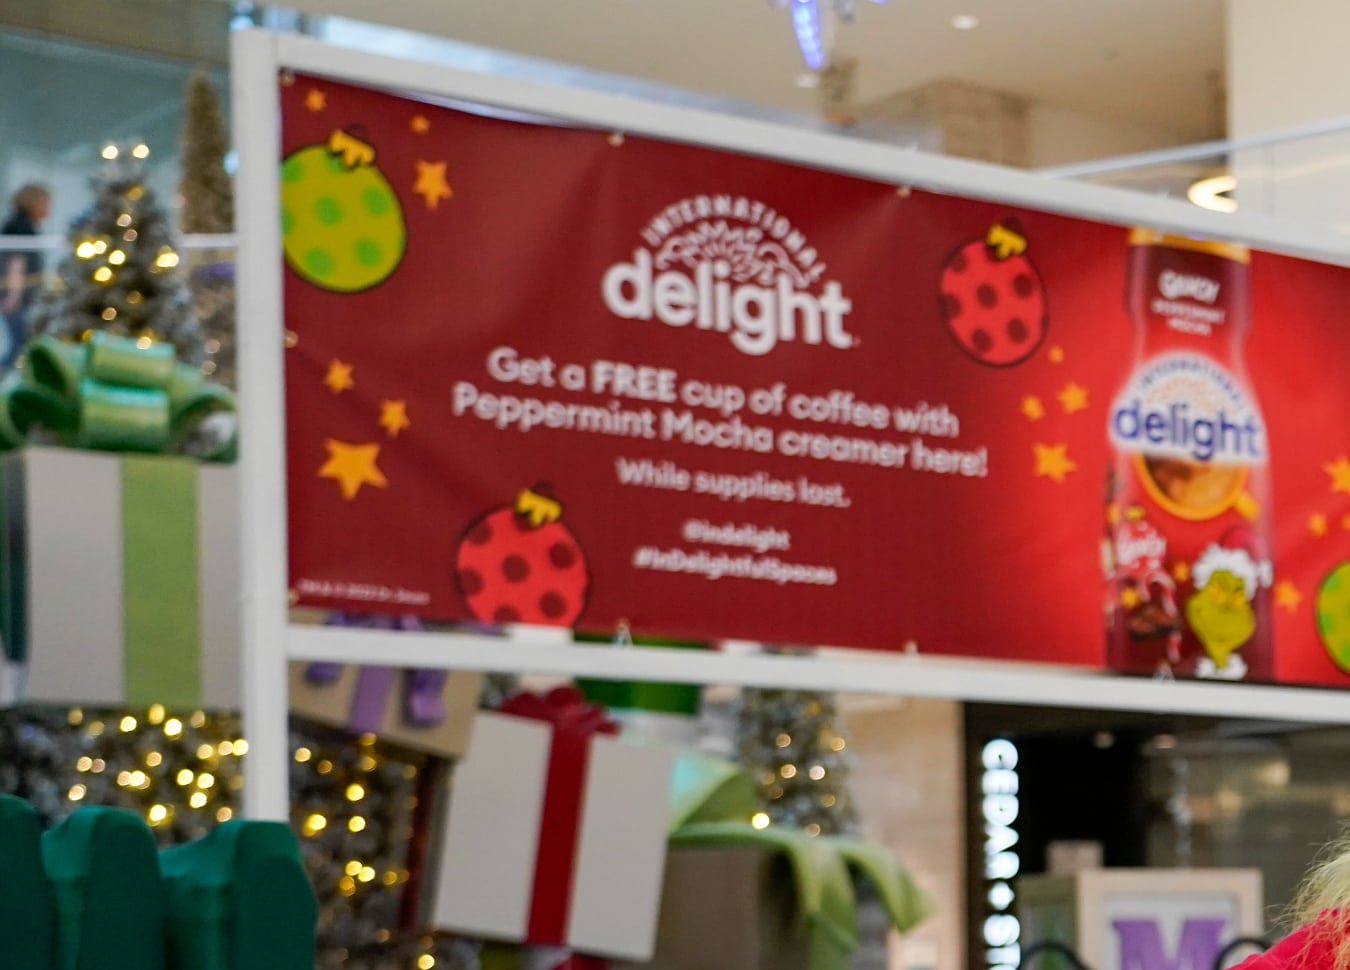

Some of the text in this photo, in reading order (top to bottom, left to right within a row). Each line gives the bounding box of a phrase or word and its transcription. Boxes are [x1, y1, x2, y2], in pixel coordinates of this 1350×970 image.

[641, 194, 827, 283] INTERNATIONAL
[602, 247, 853, 356] delight
[452, 380, 988, 478] Peppermint Mocha creamer here!
[486, 346, 960, 438] Get a FREE cup of coffee with
[1115, 399, 1260, 462] delight
[614, 456, 691, 492] While
[693, 470, 796, 503] supplies
[982, 739, 1019, 879] CEDAR
